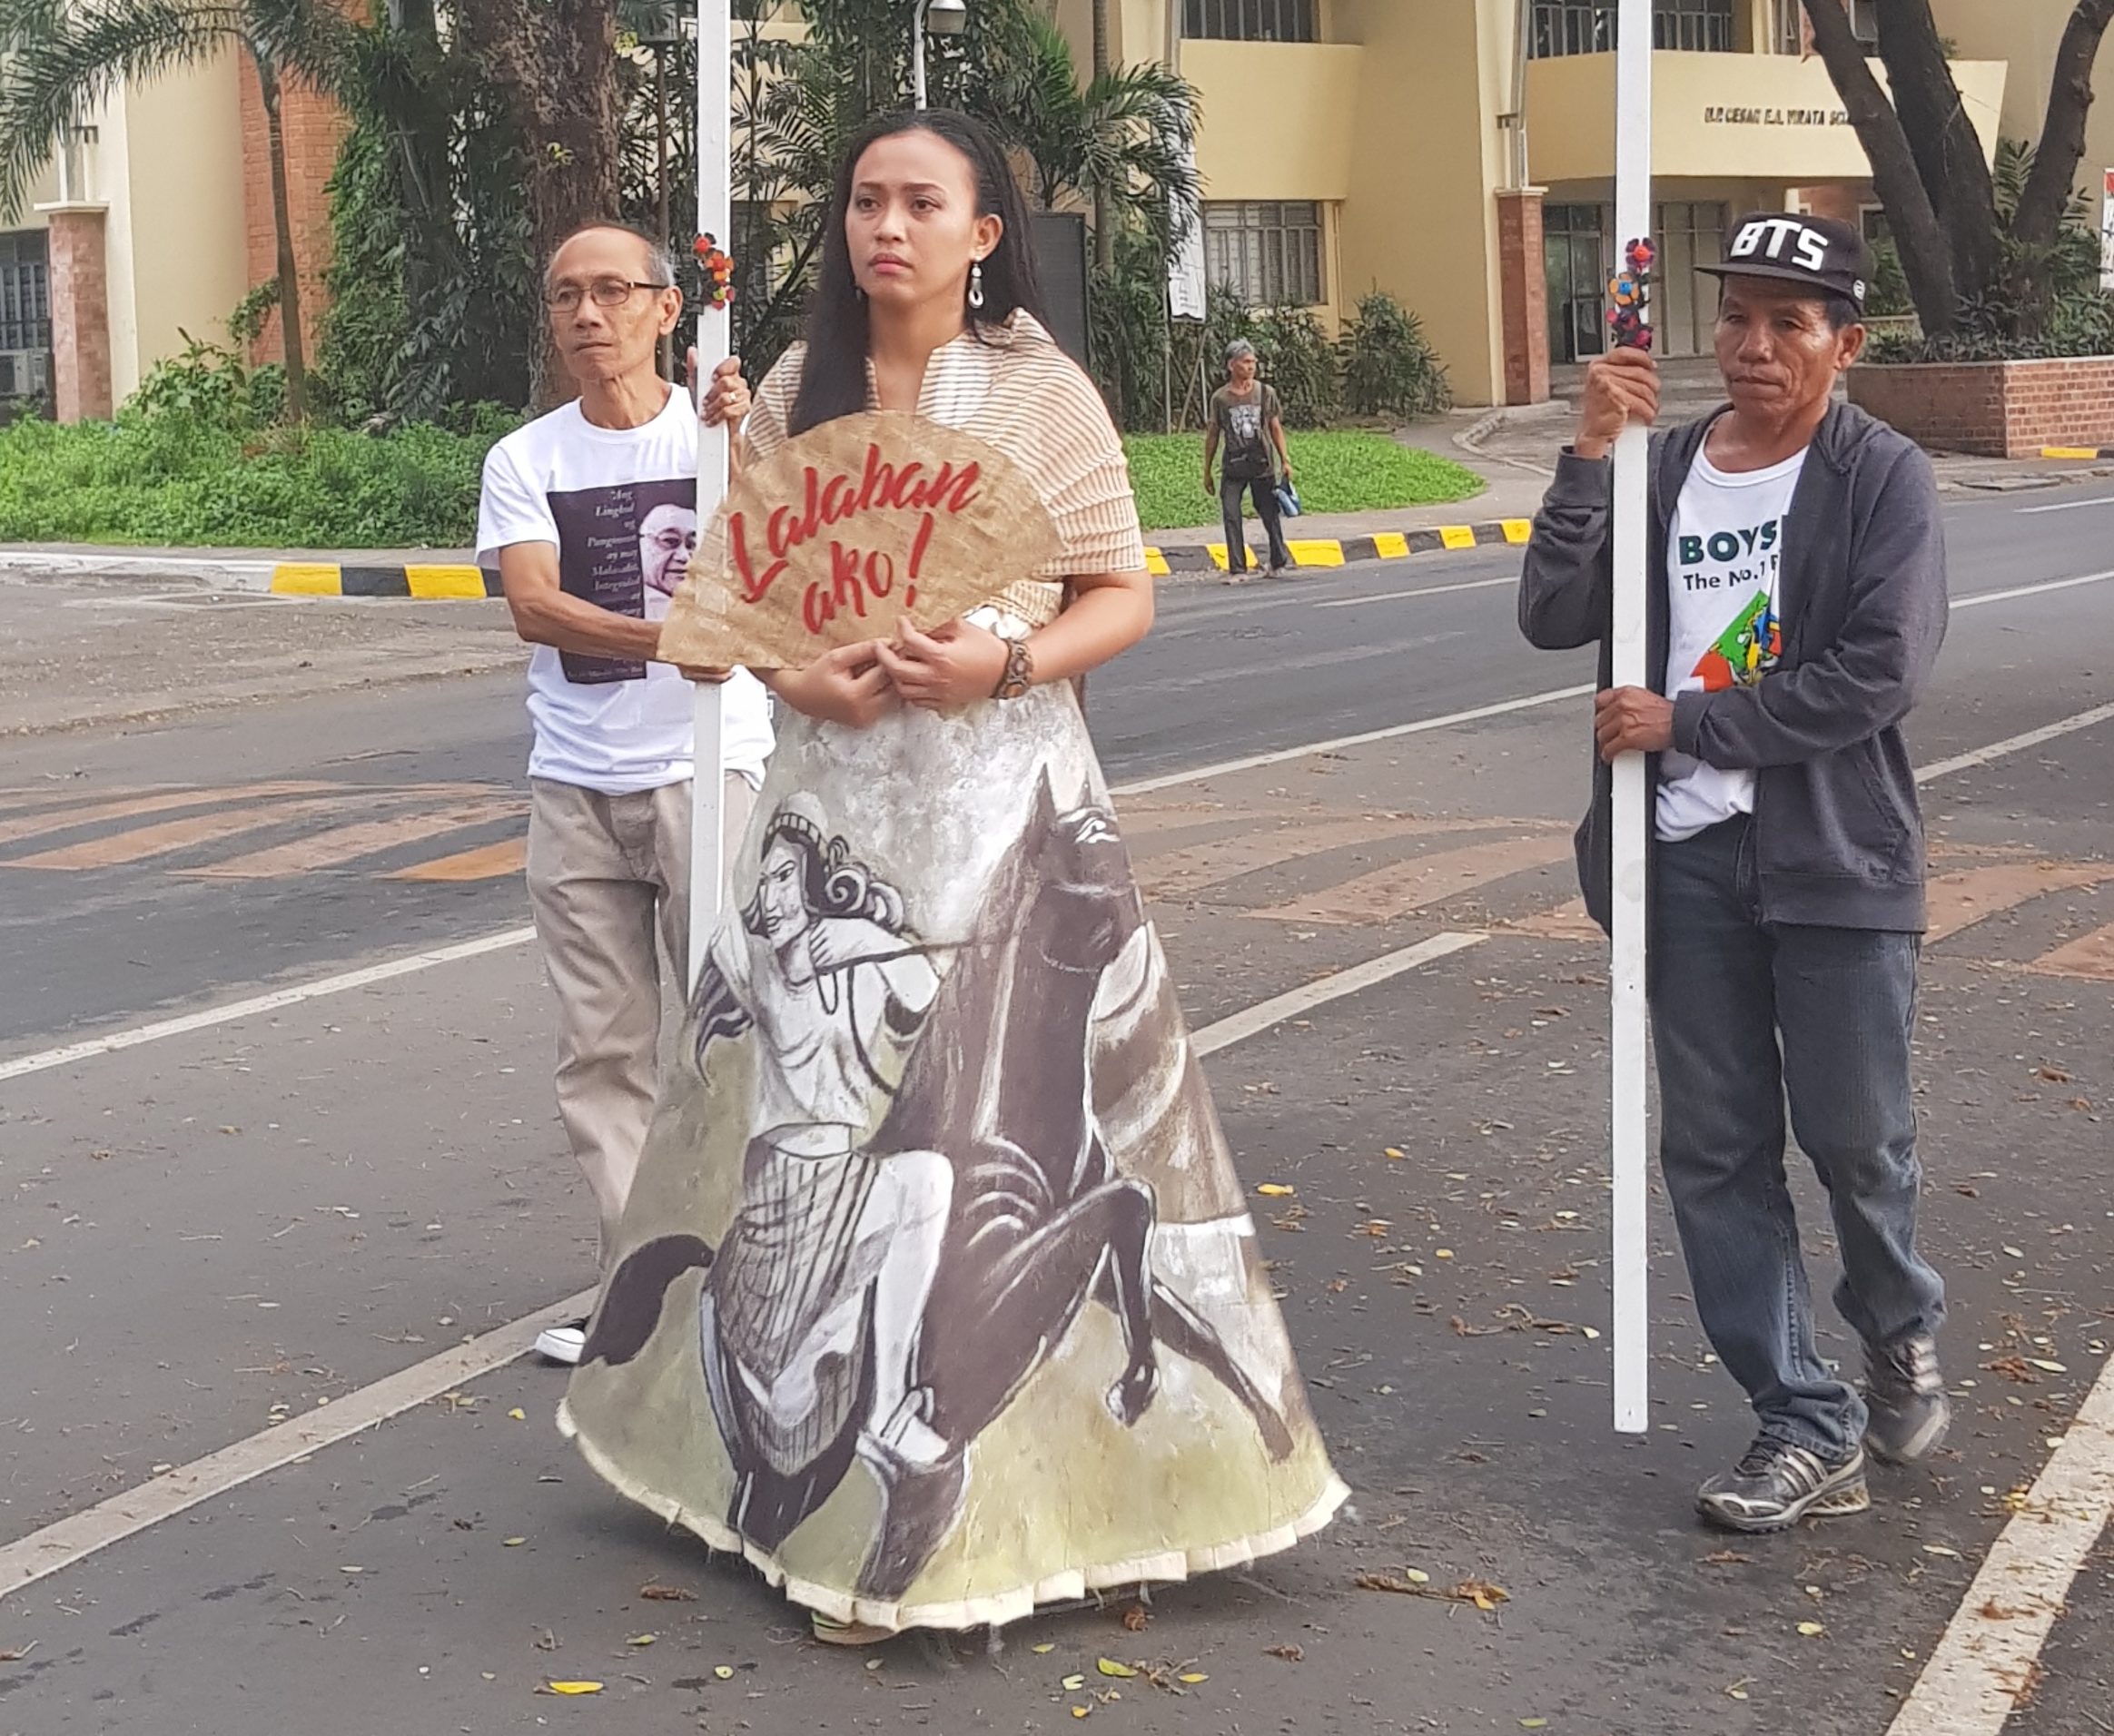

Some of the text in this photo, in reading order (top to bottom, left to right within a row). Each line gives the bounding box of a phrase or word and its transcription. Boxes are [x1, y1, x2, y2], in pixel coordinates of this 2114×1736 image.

[1725, 108, 1762, 124] CESAR
[1787, 110, 1824, 125] VIRATA
[1730, 219, 1828, 271] BTS
[730, 442, 982, 604] Lalahan
[1678, 519, 1778, 566] BOYS
[1683, 572, 1721, 591] The
